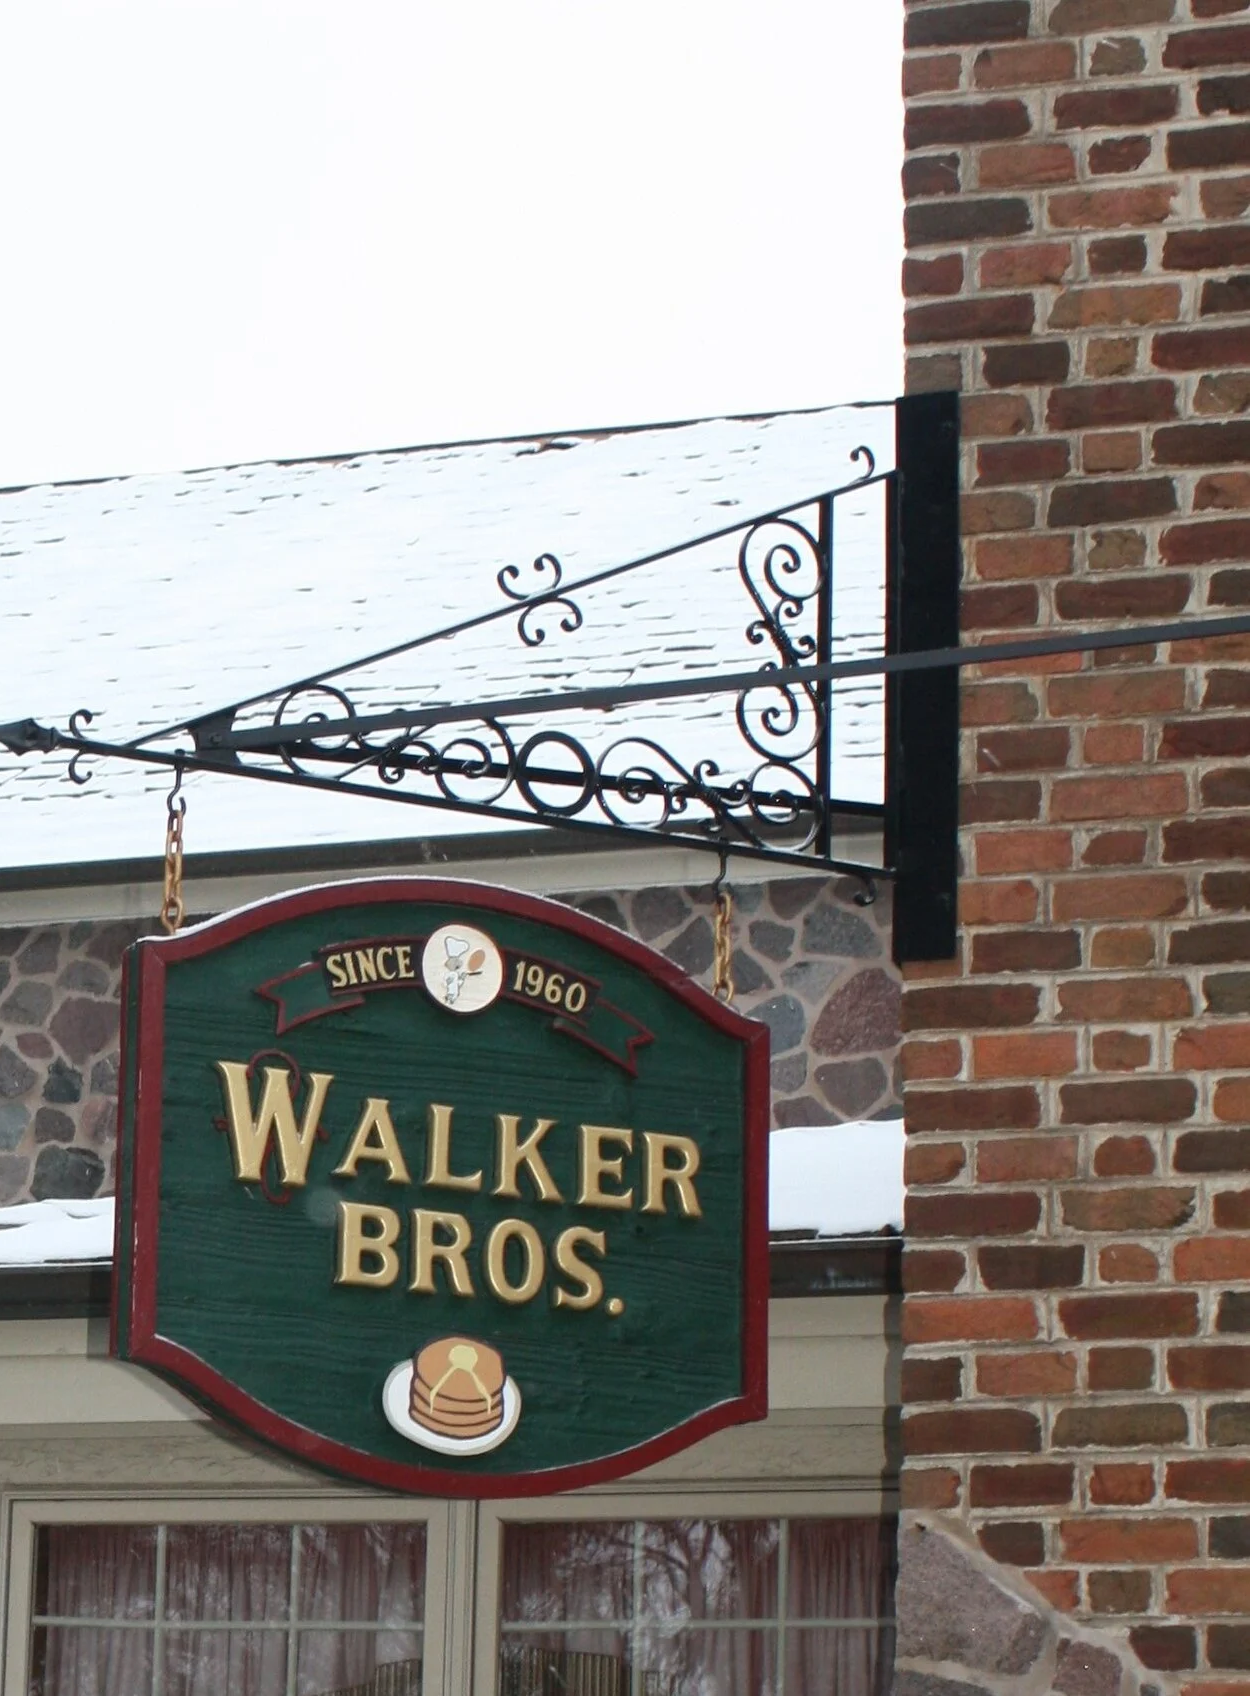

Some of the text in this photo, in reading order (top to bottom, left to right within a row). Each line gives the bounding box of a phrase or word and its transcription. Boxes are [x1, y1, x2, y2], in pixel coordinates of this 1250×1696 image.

[325, 945, 587, 1014] SINCE 1960
[217, 1060, 703, 1217] WALKER
[335, 1201, 625, 1316] BROS.
